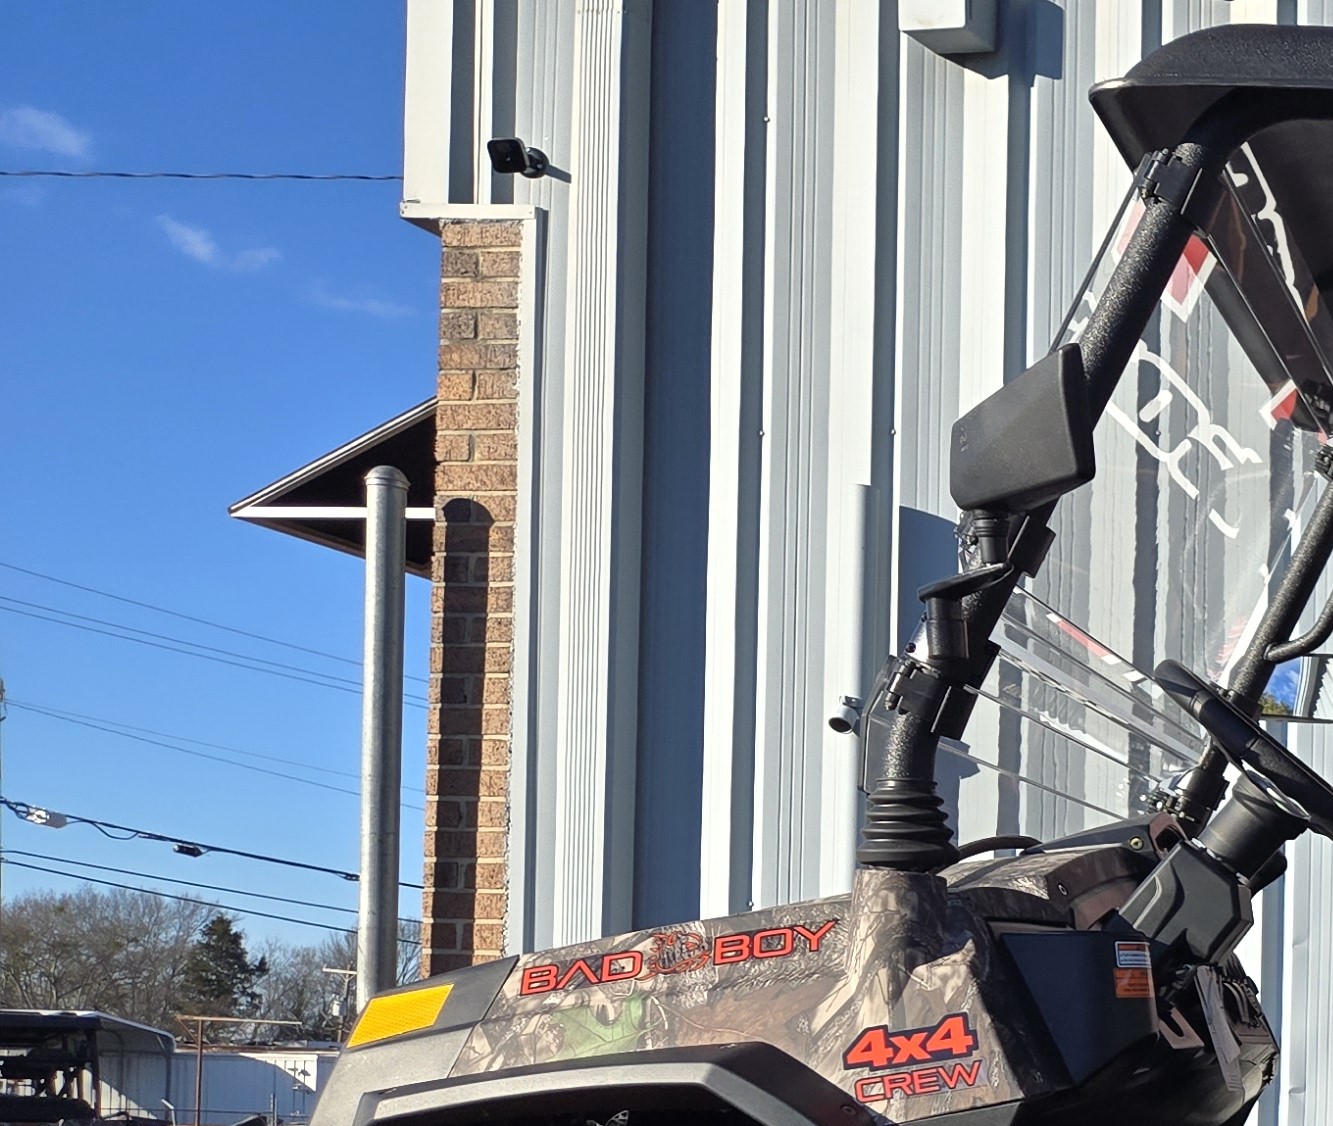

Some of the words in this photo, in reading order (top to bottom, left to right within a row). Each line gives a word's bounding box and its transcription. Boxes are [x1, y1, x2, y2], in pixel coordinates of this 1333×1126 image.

[520, 950, 643, 996] BAD
[713, 918, 840, 966] BOY
[844, 1014, 976, 1069] 4x4
[855, 1060, 982, 1103] CREW
